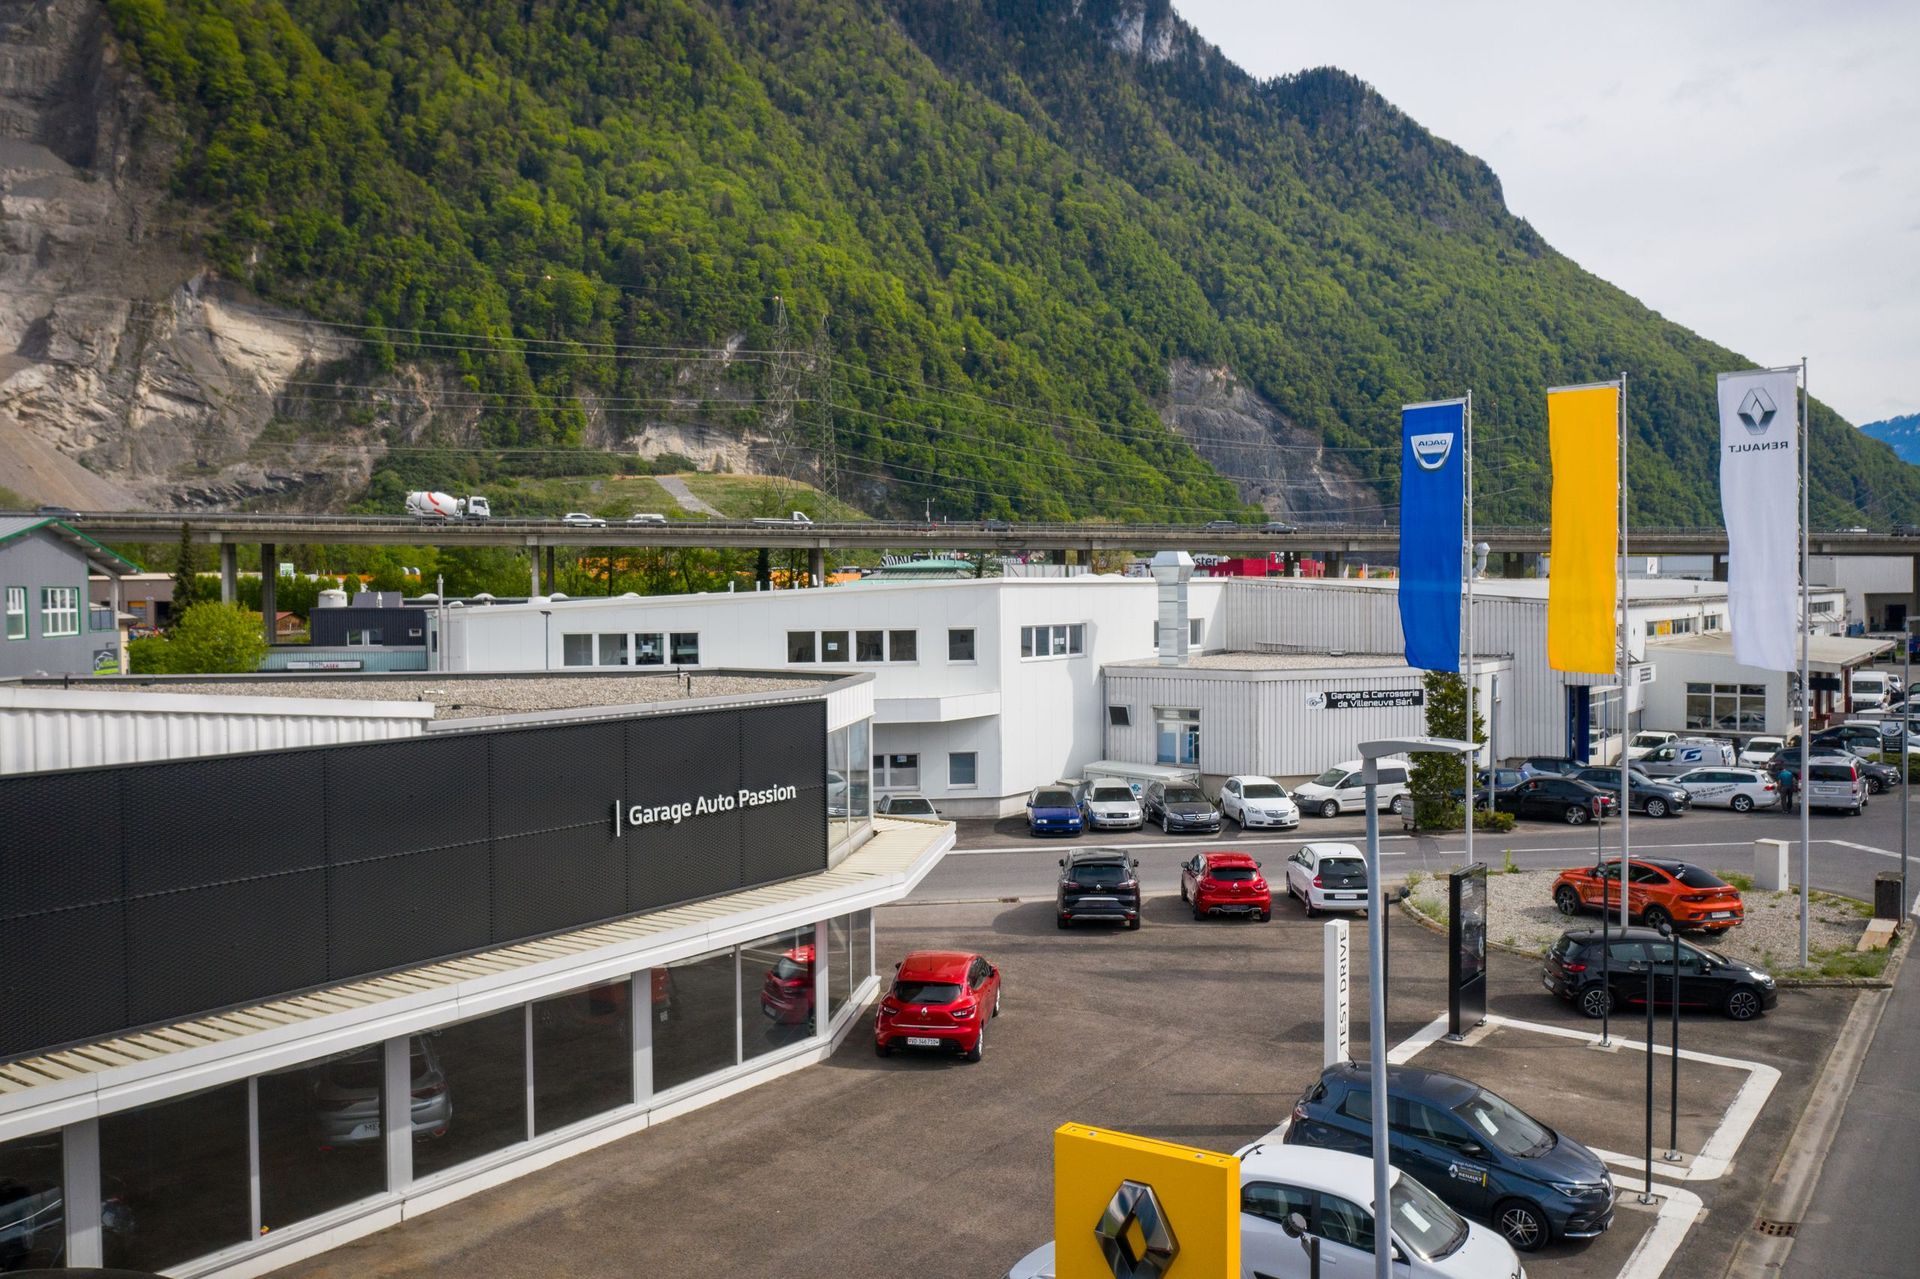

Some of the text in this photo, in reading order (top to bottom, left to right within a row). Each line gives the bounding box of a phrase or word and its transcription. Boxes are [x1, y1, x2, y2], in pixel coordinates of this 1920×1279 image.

[1331, 690, 1420, 700] Garage & Carrosserie
[1337, 700, 1348, 708] de
[1350, 699, 1394, 708] Villeneuve
[629, 784, 797, 825] Garage Auto Passion
[1339, 928, 1347, 1050] TEST DRIVE
